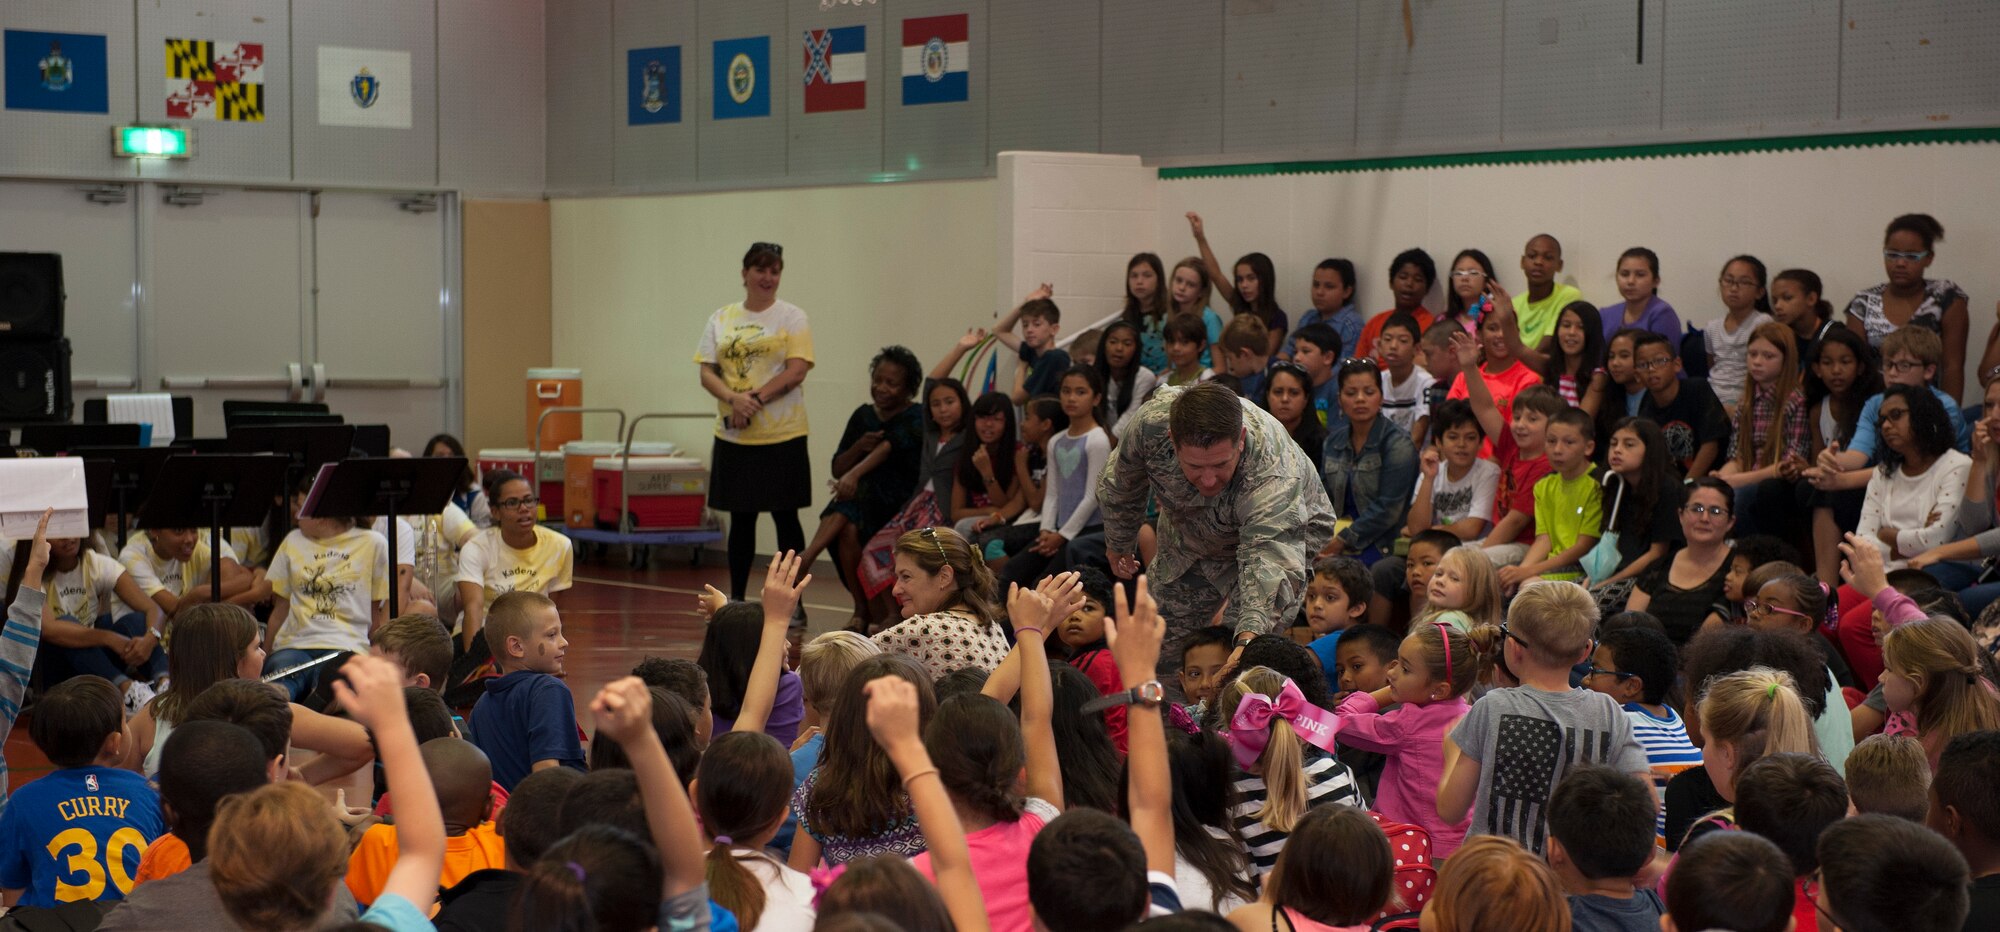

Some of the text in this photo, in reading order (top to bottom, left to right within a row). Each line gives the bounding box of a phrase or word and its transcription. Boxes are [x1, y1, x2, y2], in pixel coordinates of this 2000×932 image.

[314, 550, 350, 560] Kadena
[502, 566, 537, 579] Kadena
[1293, 713, 1328, 736] PINK
[57, 796, 130, 821] CURRY
[46, 827, 149, 903] 30
